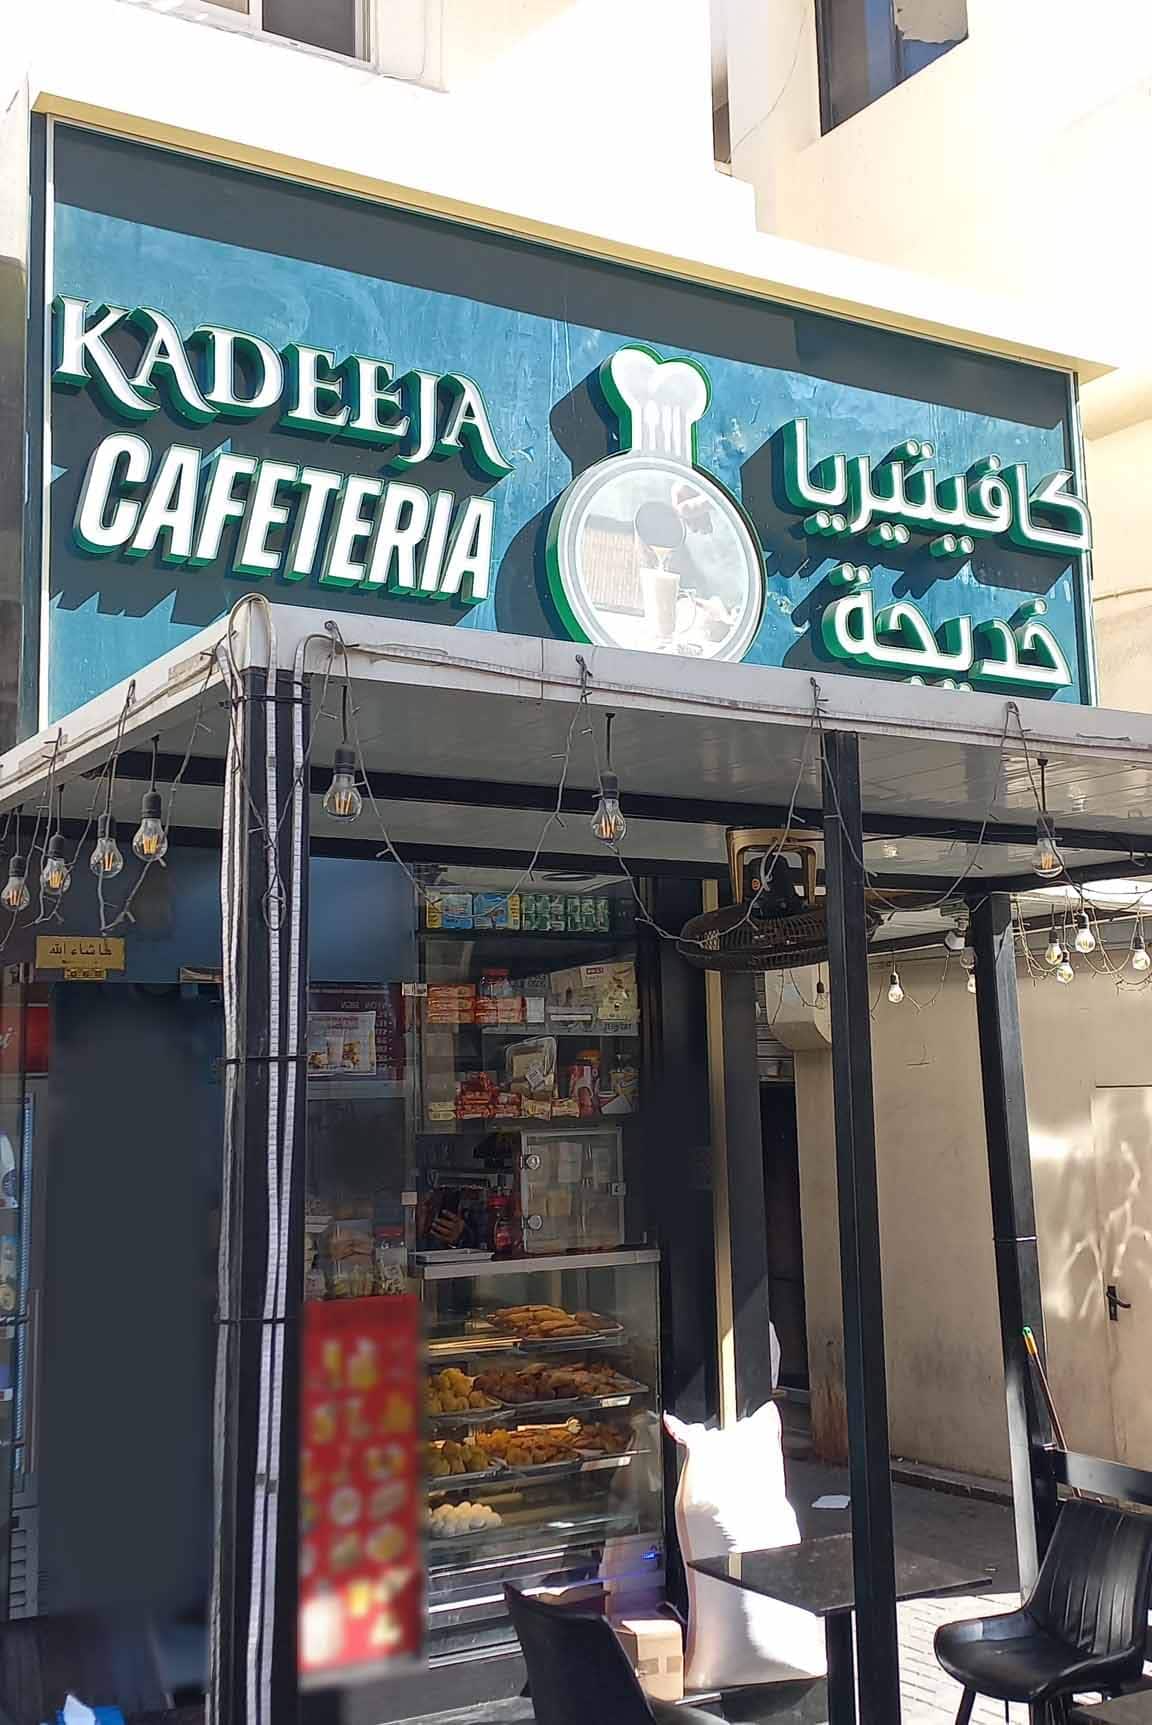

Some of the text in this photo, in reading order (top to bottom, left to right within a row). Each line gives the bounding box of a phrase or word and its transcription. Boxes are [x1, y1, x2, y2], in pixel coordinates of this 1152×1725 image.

[53, 294, 516, 475] KADEEJA
[76, 433, 496, 604] CAFETERIA
[786, 417, 1093, 554] كافيتيريا
[823, 562, 1073, 691] خديجة
[48, 943, 66, 955] الله
[70, 943, 95, 956] شاء
